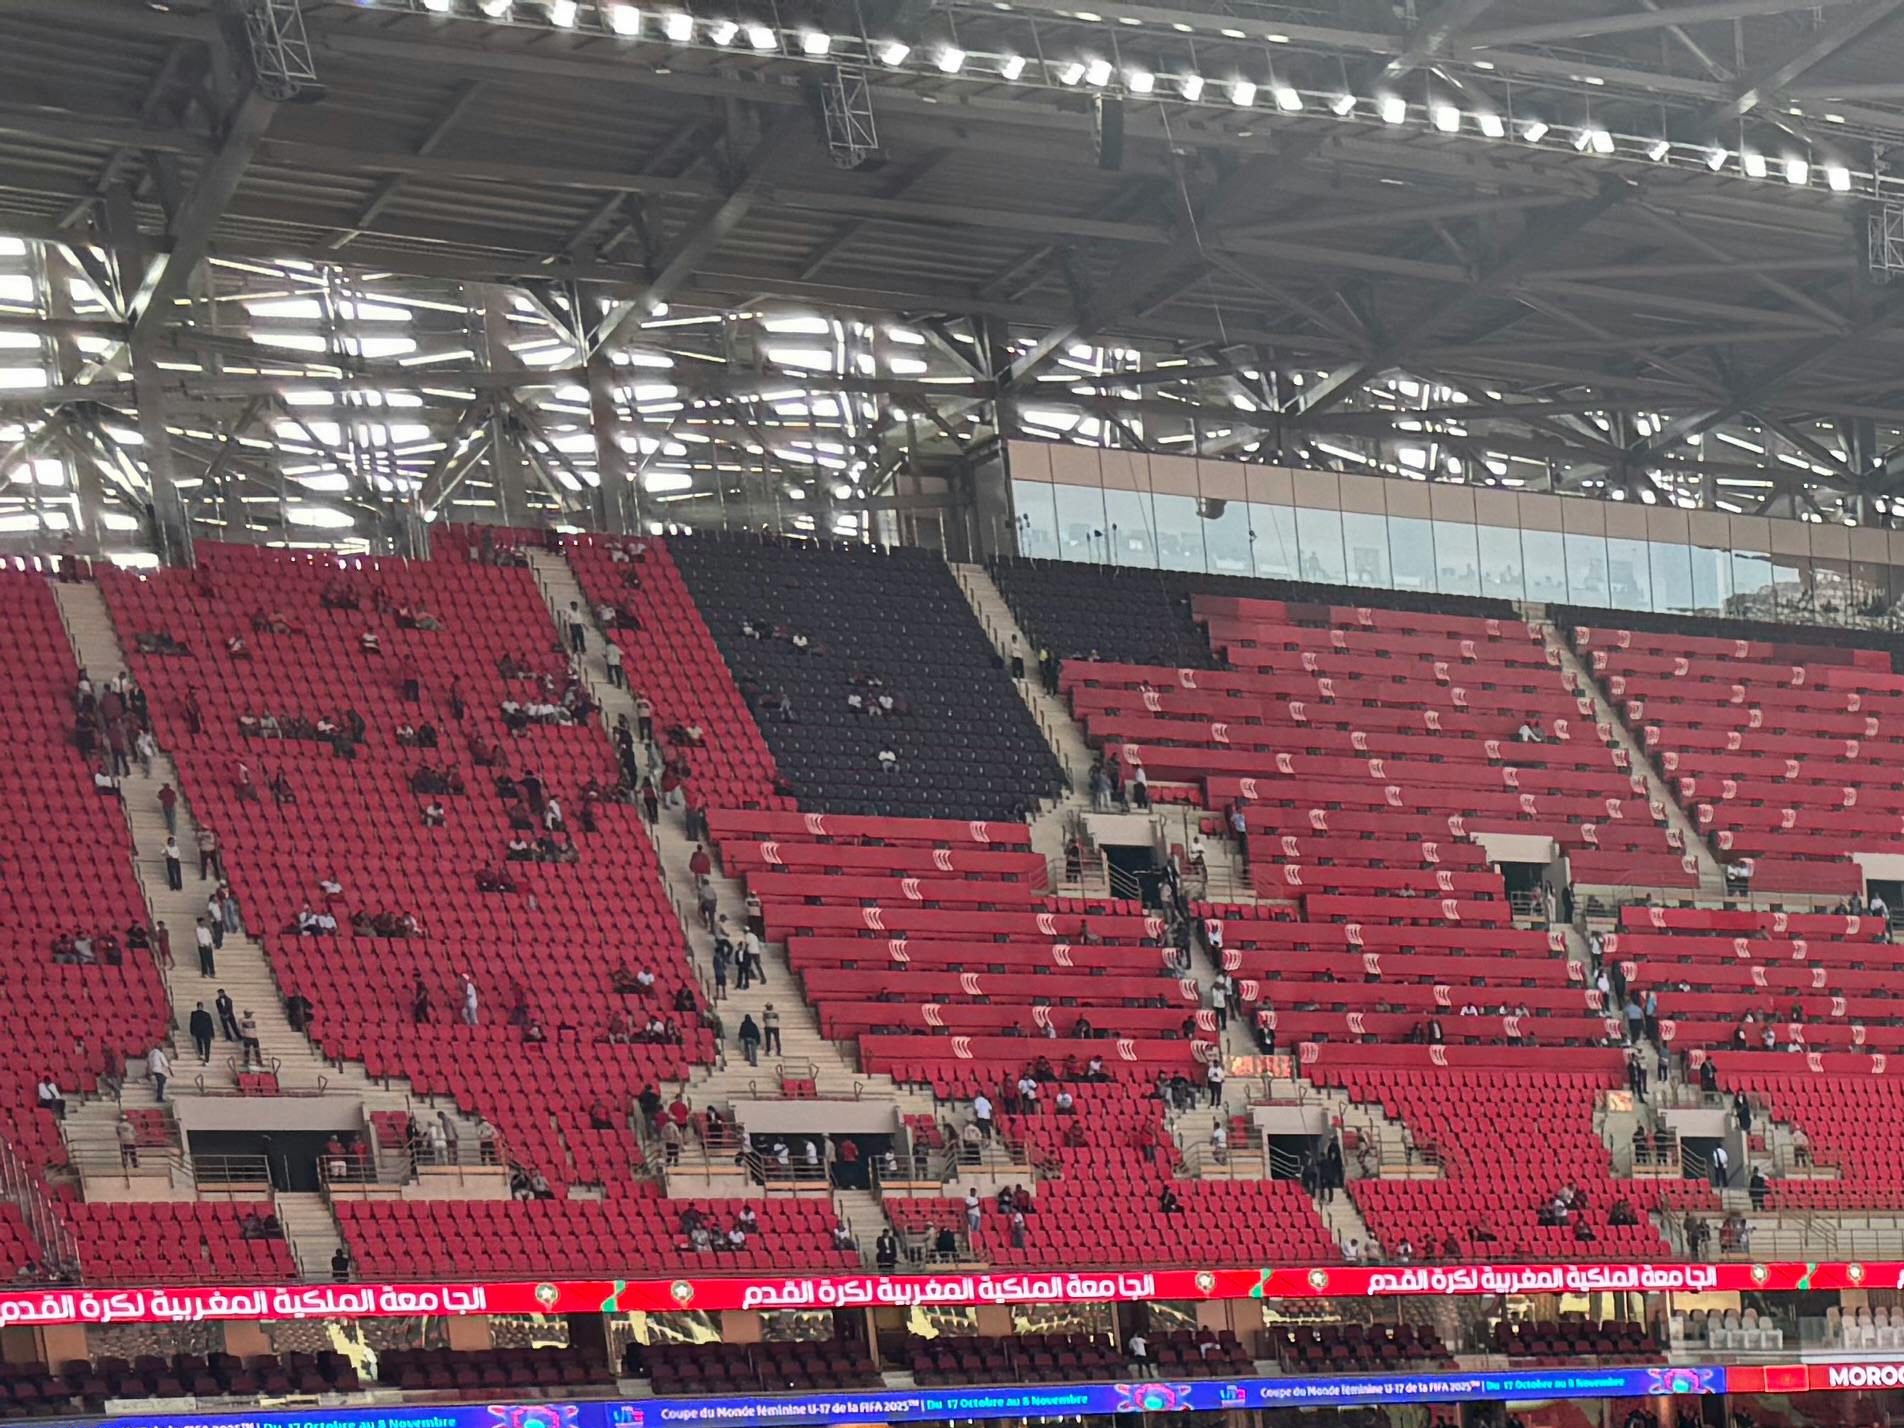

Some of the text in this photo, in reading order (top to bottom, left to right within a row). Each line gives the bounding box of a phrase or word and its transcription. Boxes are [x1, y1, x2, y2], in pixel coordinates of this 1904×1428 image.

[878, 1277, 974, 1304] المغربية
[979, 1276, 1062, 1303] الملكية
[1368, 1269, 1428, 1295] القدم
[1431, 1268, 1477, 1293] لكرة
[1481, 1266, 1563, 1293] المغربية
[1567, 1265, 1638, 1291] الملكية
[151, 1291, 268, 1321] المغربية
[274, 1289, 375, 1318] الملكية
[743, 1281, 814, 1309] القدم
[819, 1280, 872, 1306] لكرة
[80, 1293, 144, 1322] لكرة
